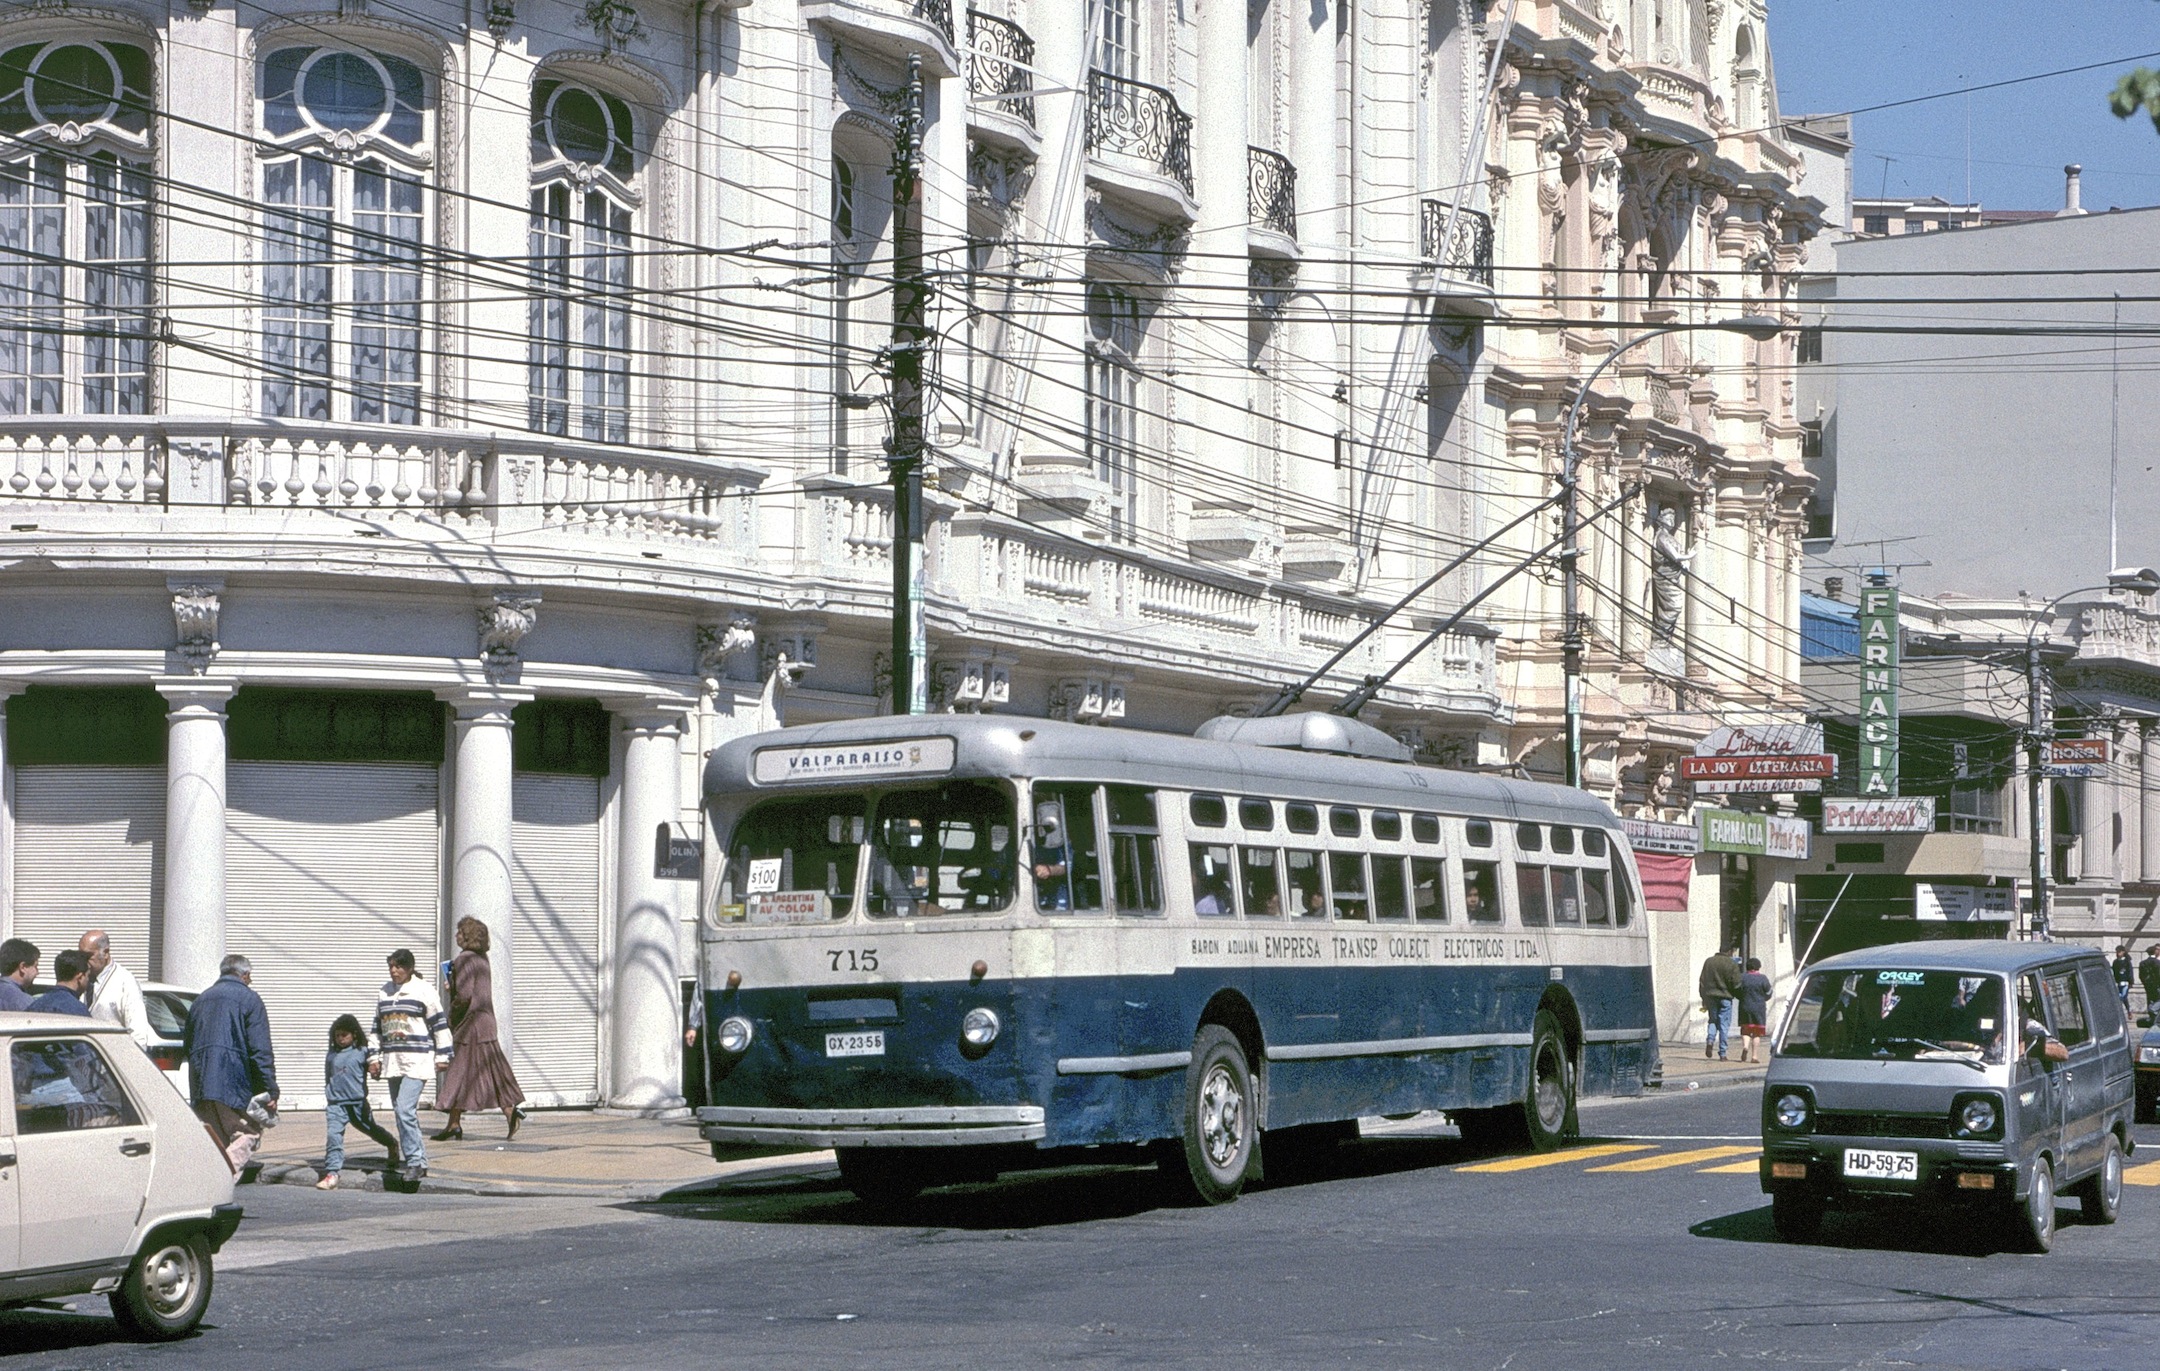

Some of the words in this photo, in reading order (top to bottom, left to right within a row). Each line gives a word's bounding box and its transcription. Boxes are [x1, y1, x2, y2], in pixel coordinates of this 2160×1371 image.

[1866, 593, 1889, 793] FARMACIA
[790, 750, 904, 768] VALPARAISO
[1690, 762, 1707, 774] LA
[1711, 762, 1737, 774] JOY
[1749, 760, 1825, 774] LITERARIA
[1825, 805, 1915, 831] Principal
[1710, 818, 1763, 846] FARMACIA
[671, 847, 699, 857] OLINA
[660, 868, 678, 876] 598
[777, 903, 815, 913] COLON
[1192, 939, 1219, 954] BARON
[1227, 940, 1259, 954] ADUANA
[1265, 936, 1321, 958] EMPRESA
[1444, 938, 1504, 959] ELECTRICOS
[826, 948, 879, 972] 715
[1879, 971, 1924, 981] OAKLEY
